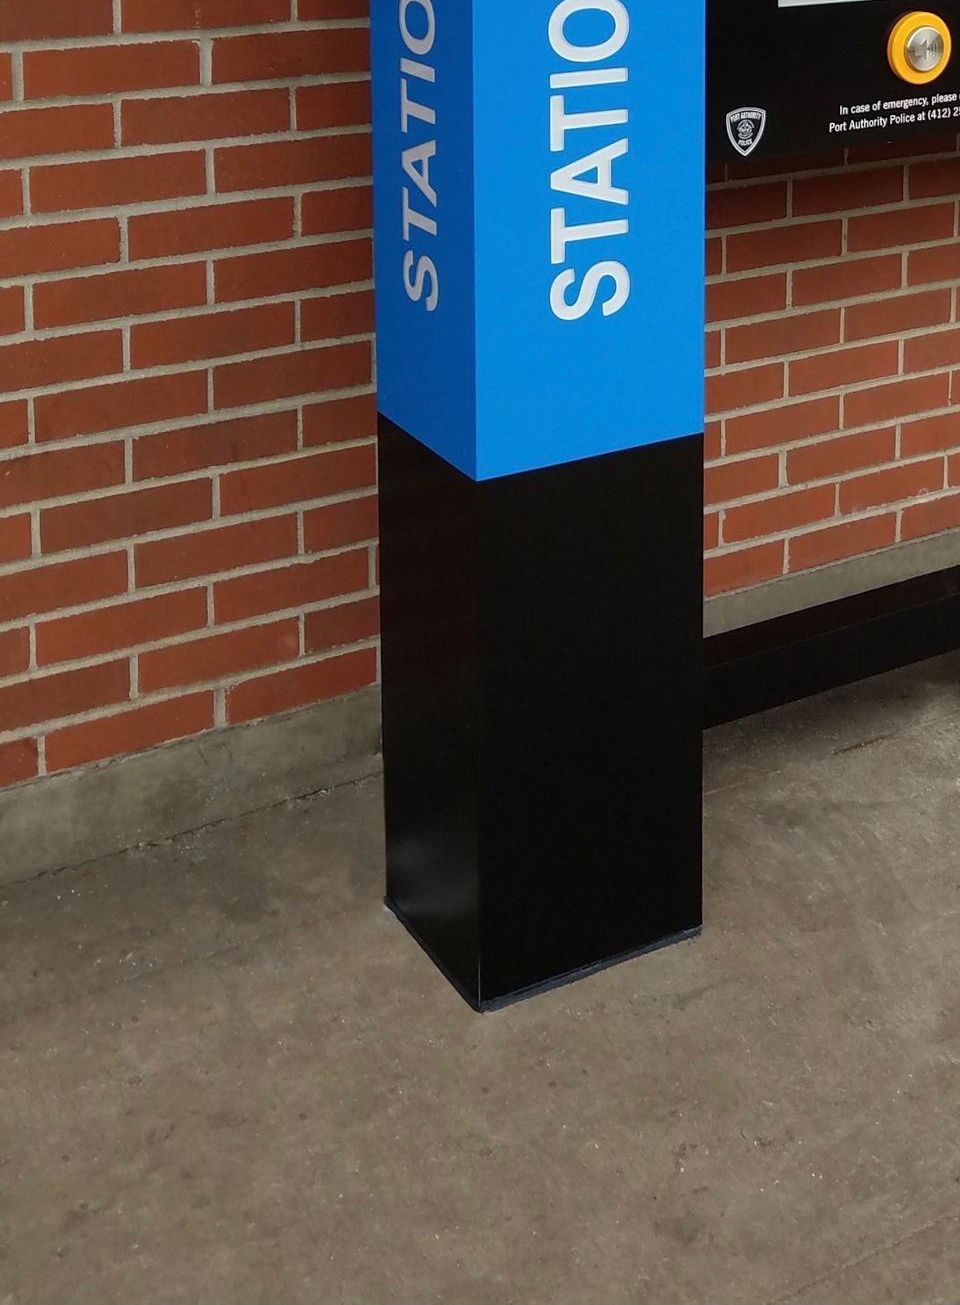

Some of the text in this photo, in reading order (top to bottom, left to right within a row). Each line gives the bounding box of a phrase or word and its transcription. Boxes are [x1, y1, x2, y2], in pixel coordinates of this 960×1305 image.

[840, 105, 848, 115] In
[850, 104, 870, 114] case
[872, 101, 881, 111] of
[883, 97, 929, 109] emergency,
[931, 93, 957, 105] please
[829, 122, 847, 133] Port
[849, 117, 888, 130] Authority
[890, 114, 915, 125] Police
[917, 111, 926, 121] at
[928, 107, 951, 121] (412)
